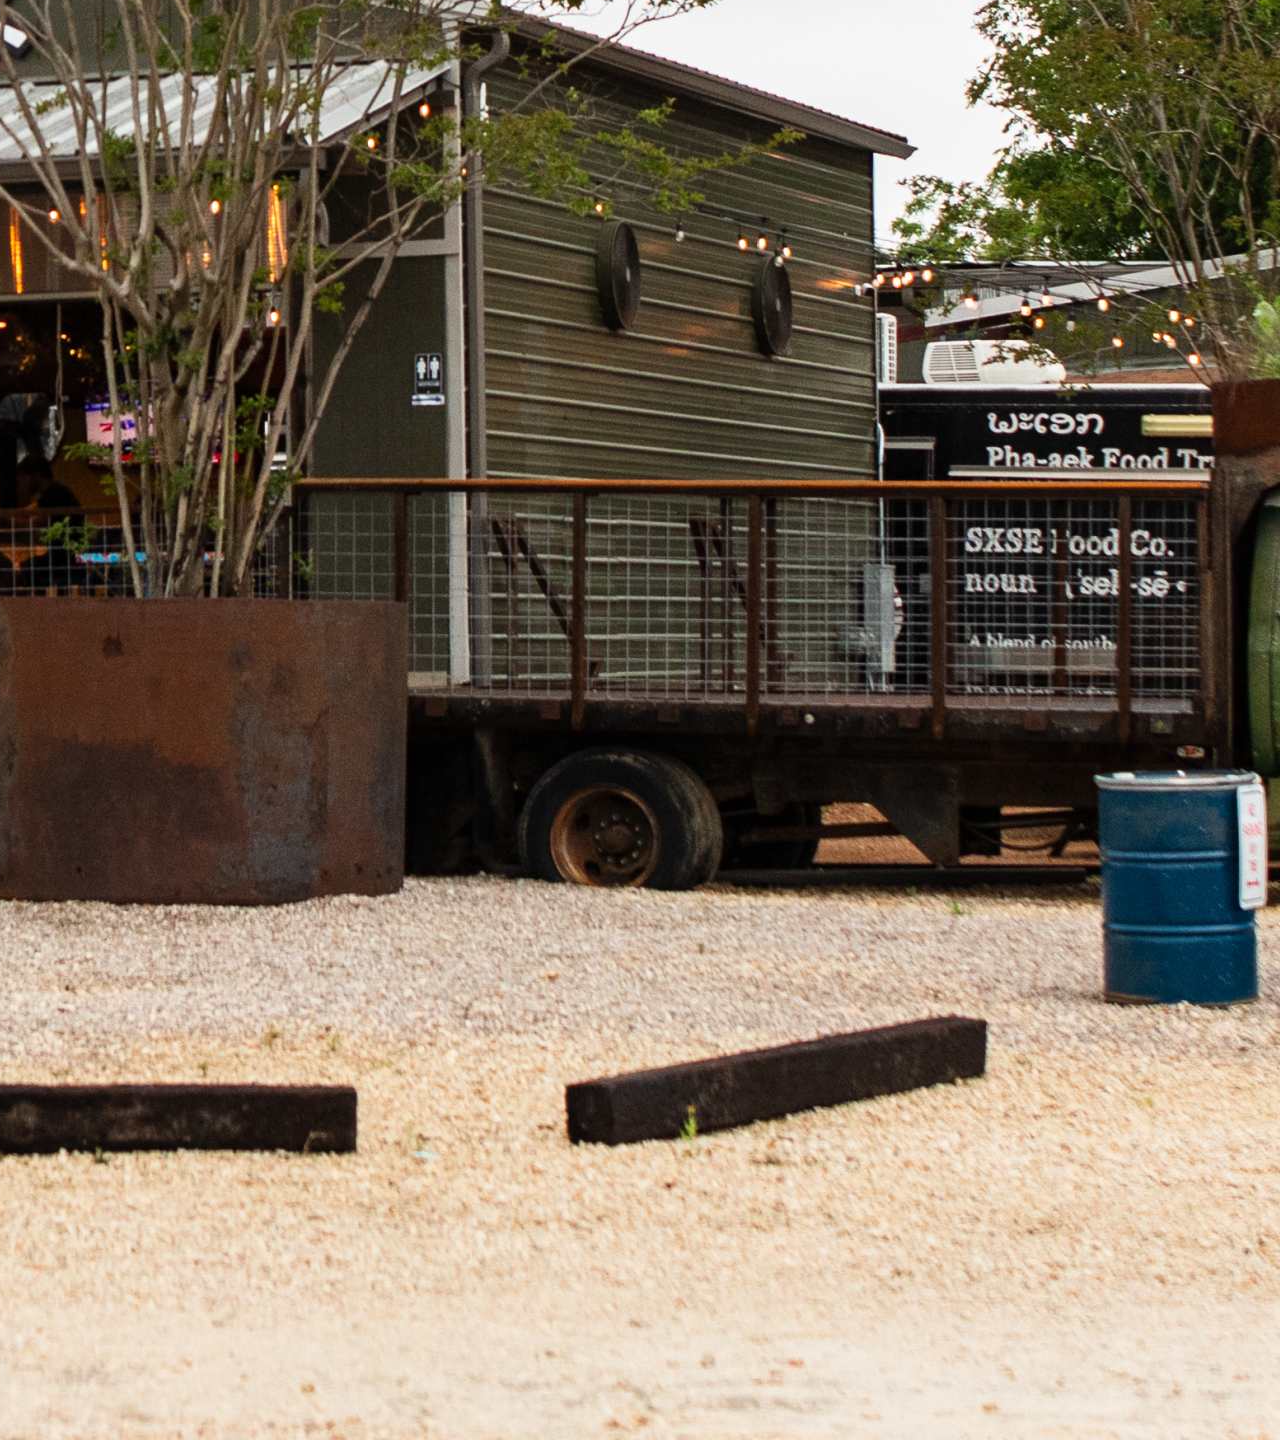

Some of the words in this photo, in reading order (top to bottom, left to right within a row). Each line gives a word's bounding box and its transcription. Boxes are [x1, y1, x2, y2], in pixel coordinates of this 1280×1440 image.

[986, 445, 1095, 469] Pha-aek
[1101, 447, 1169, 470] Food
[964, 526, 1044, 554] SXSE
[1129, 528, 1175, 557] Co.
[964, 572, 1038, 593] noun
